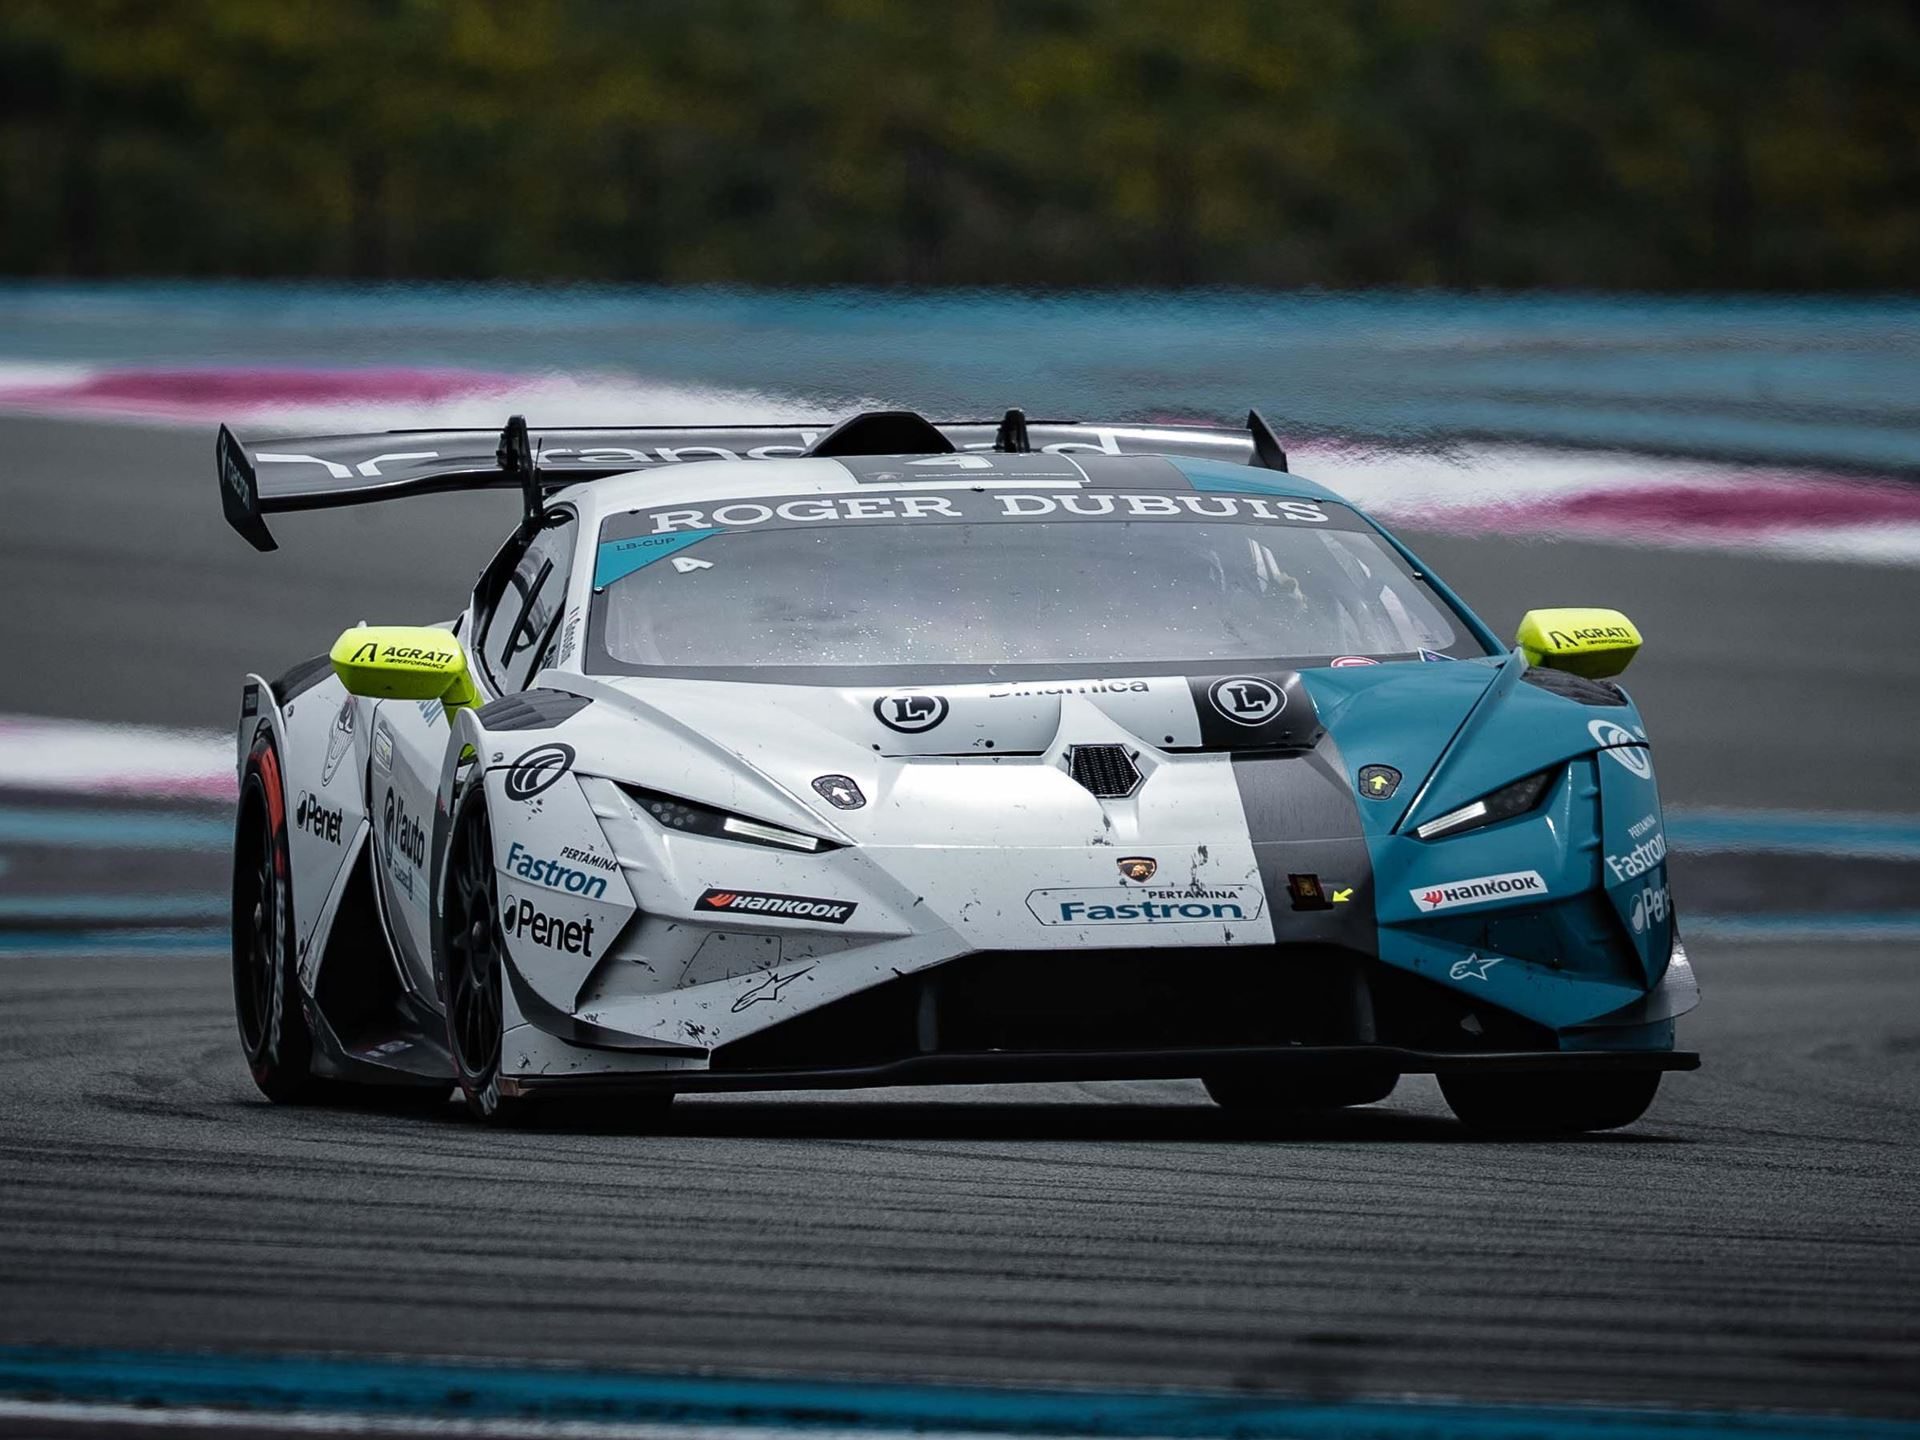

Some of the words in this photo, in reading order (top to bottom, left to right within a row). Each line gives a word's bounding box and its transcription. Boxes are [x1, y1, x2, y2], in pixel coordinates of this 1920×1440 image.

[650, 496, 962, 534] ROGER
[994, 494, 1329, 523] DUBUIS
[616, 537, 676, 551] LB-CUP
[1573, 627, 1631, 640] AGRATI
[381, 646, 454, 663] AGRATI
[989, 680, 1150, 698] mica
[305, 793, 343, 847] Penet
[559, 846, 618, 873] PERTAMINA
[1605, 832, 1667, 882] Fastron
[505, 841, 608, 899] Fastron
[1149, 890, 1239, 900] PERTAMINA
[1060, 902, 1244, 921] Fastron
[516, 898, 595, 958] Penet
